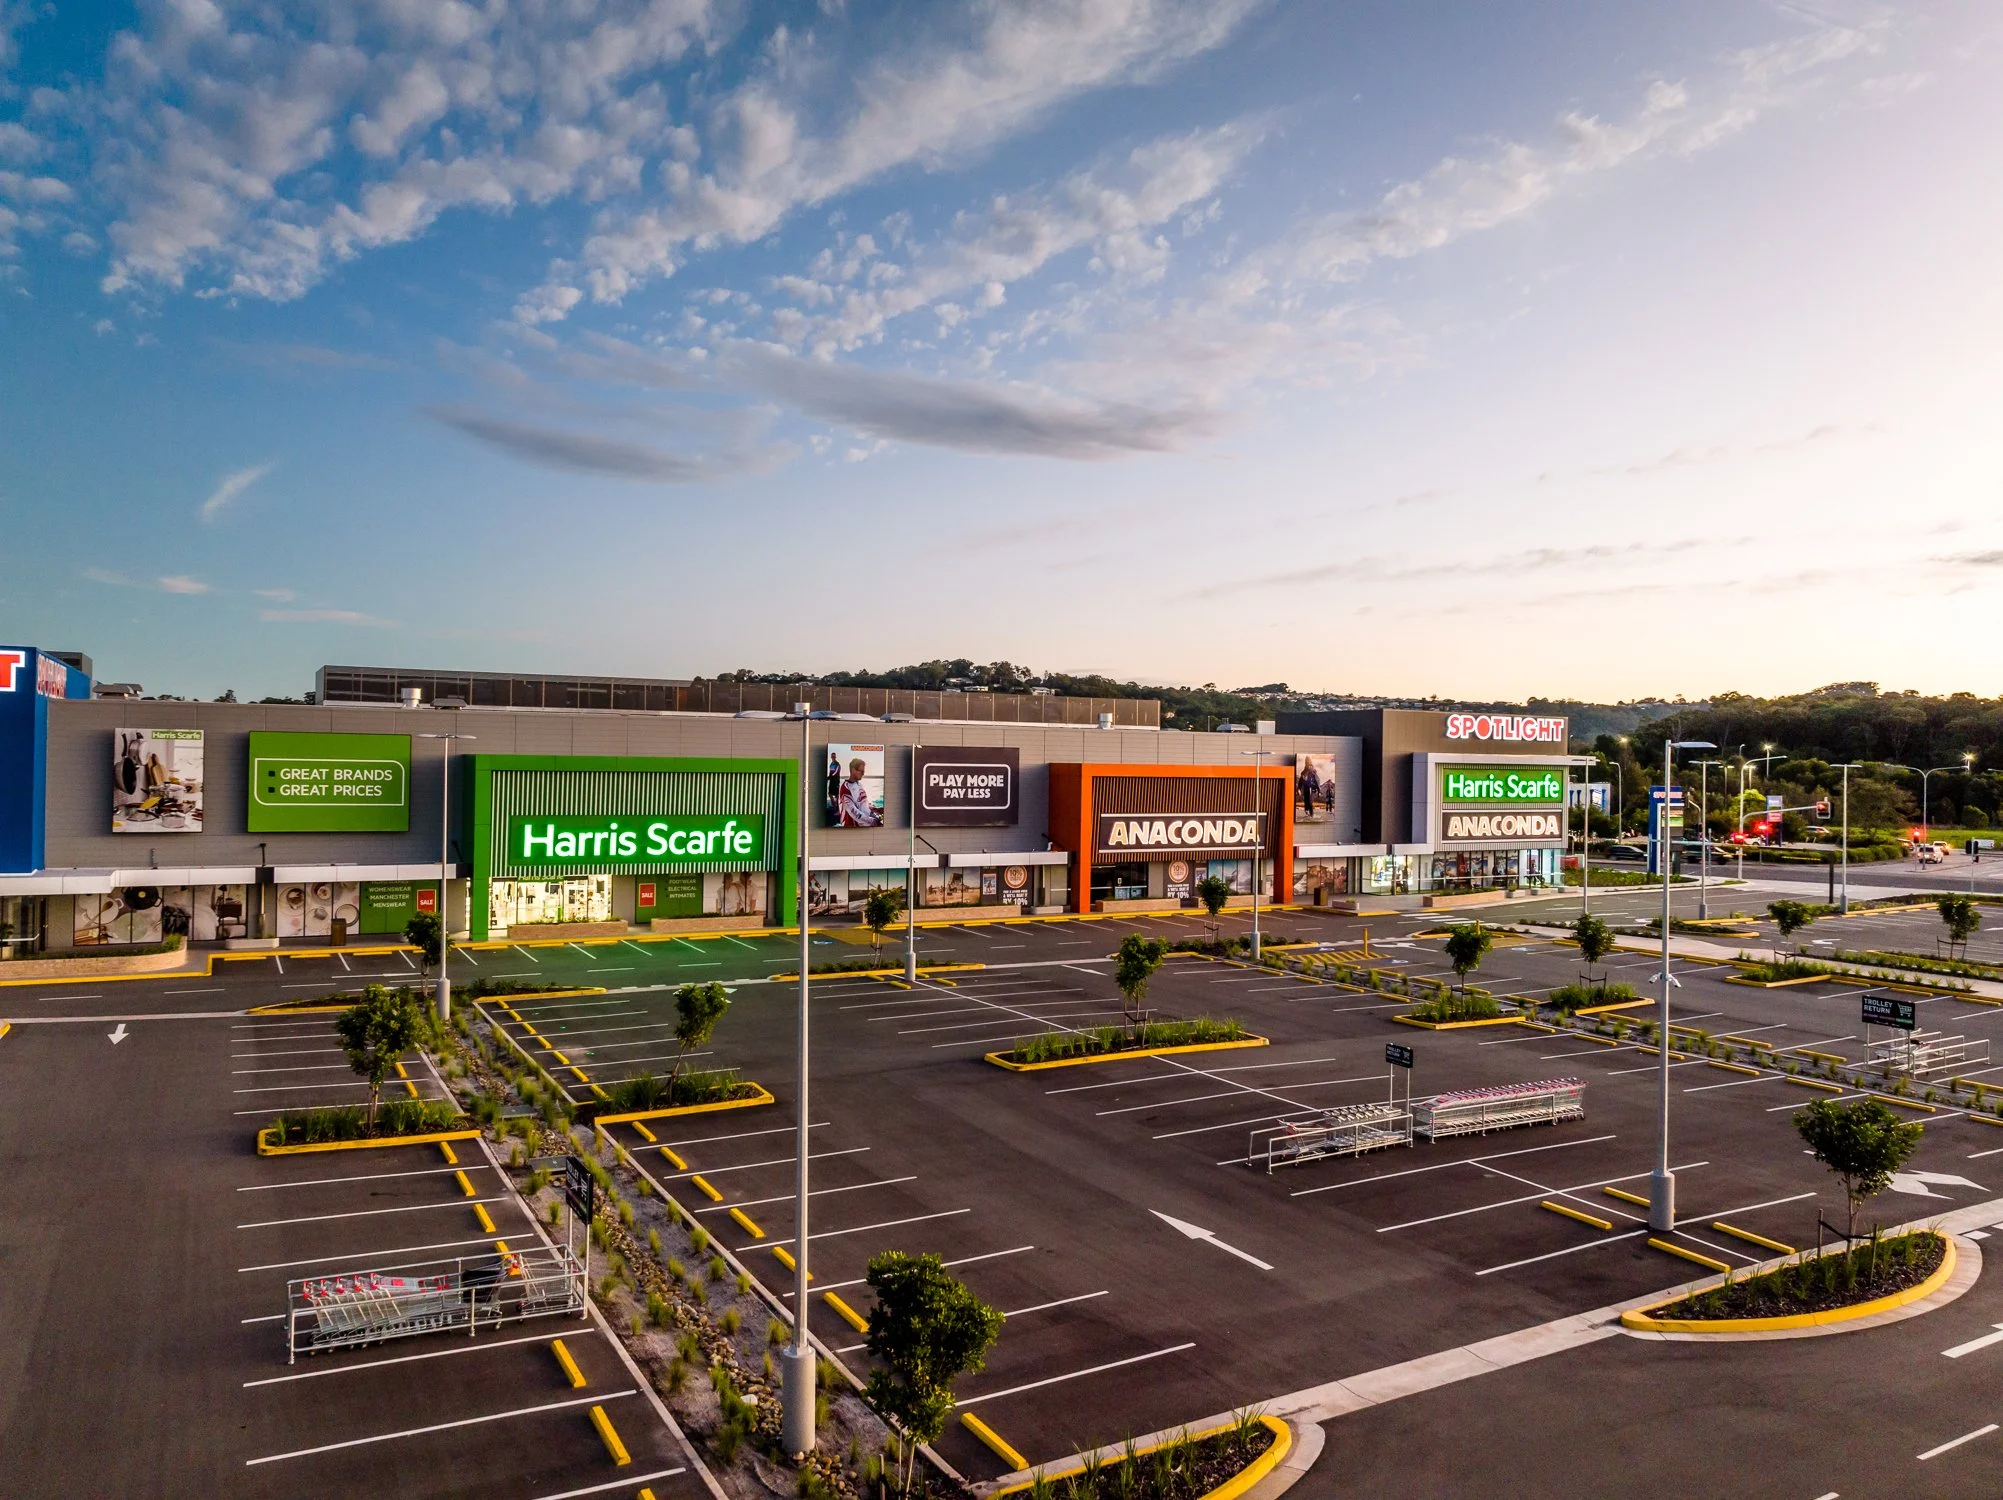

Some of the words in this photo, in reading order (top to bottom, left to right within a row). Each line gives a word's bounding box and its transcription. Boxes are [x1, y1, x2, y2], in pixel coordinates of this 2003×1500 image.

[1447, 714, 1564, 742] SPOTLIGHT
[280, 768, 329, 780] GREAT
[333, 769, 393, 781] BRANDS
[929, 774, 964, 787] PLAY
[966, 775, 1004, 787] MORE
[280, 784, 328, 796] GREAT
[333, 785, 382, 797] PRICES
[1448, 773, 1504, 798] Harris
[1506, 773, 1560, 798] Scarfe
[943, 788, 966, 798] PAY
[967, 788, 991, 798] LESS
[1447, 815, 1560, 837] ANACONDA
[523, 823, 637, 857] Harris
[646, 820, 753, 856] Scarfe
[1108, 820, 1261, 846] ANACONDA
[1864, 998, 1893, 1008] TROLLEY
[1864, 1005, 1891, 1014] RETURN
